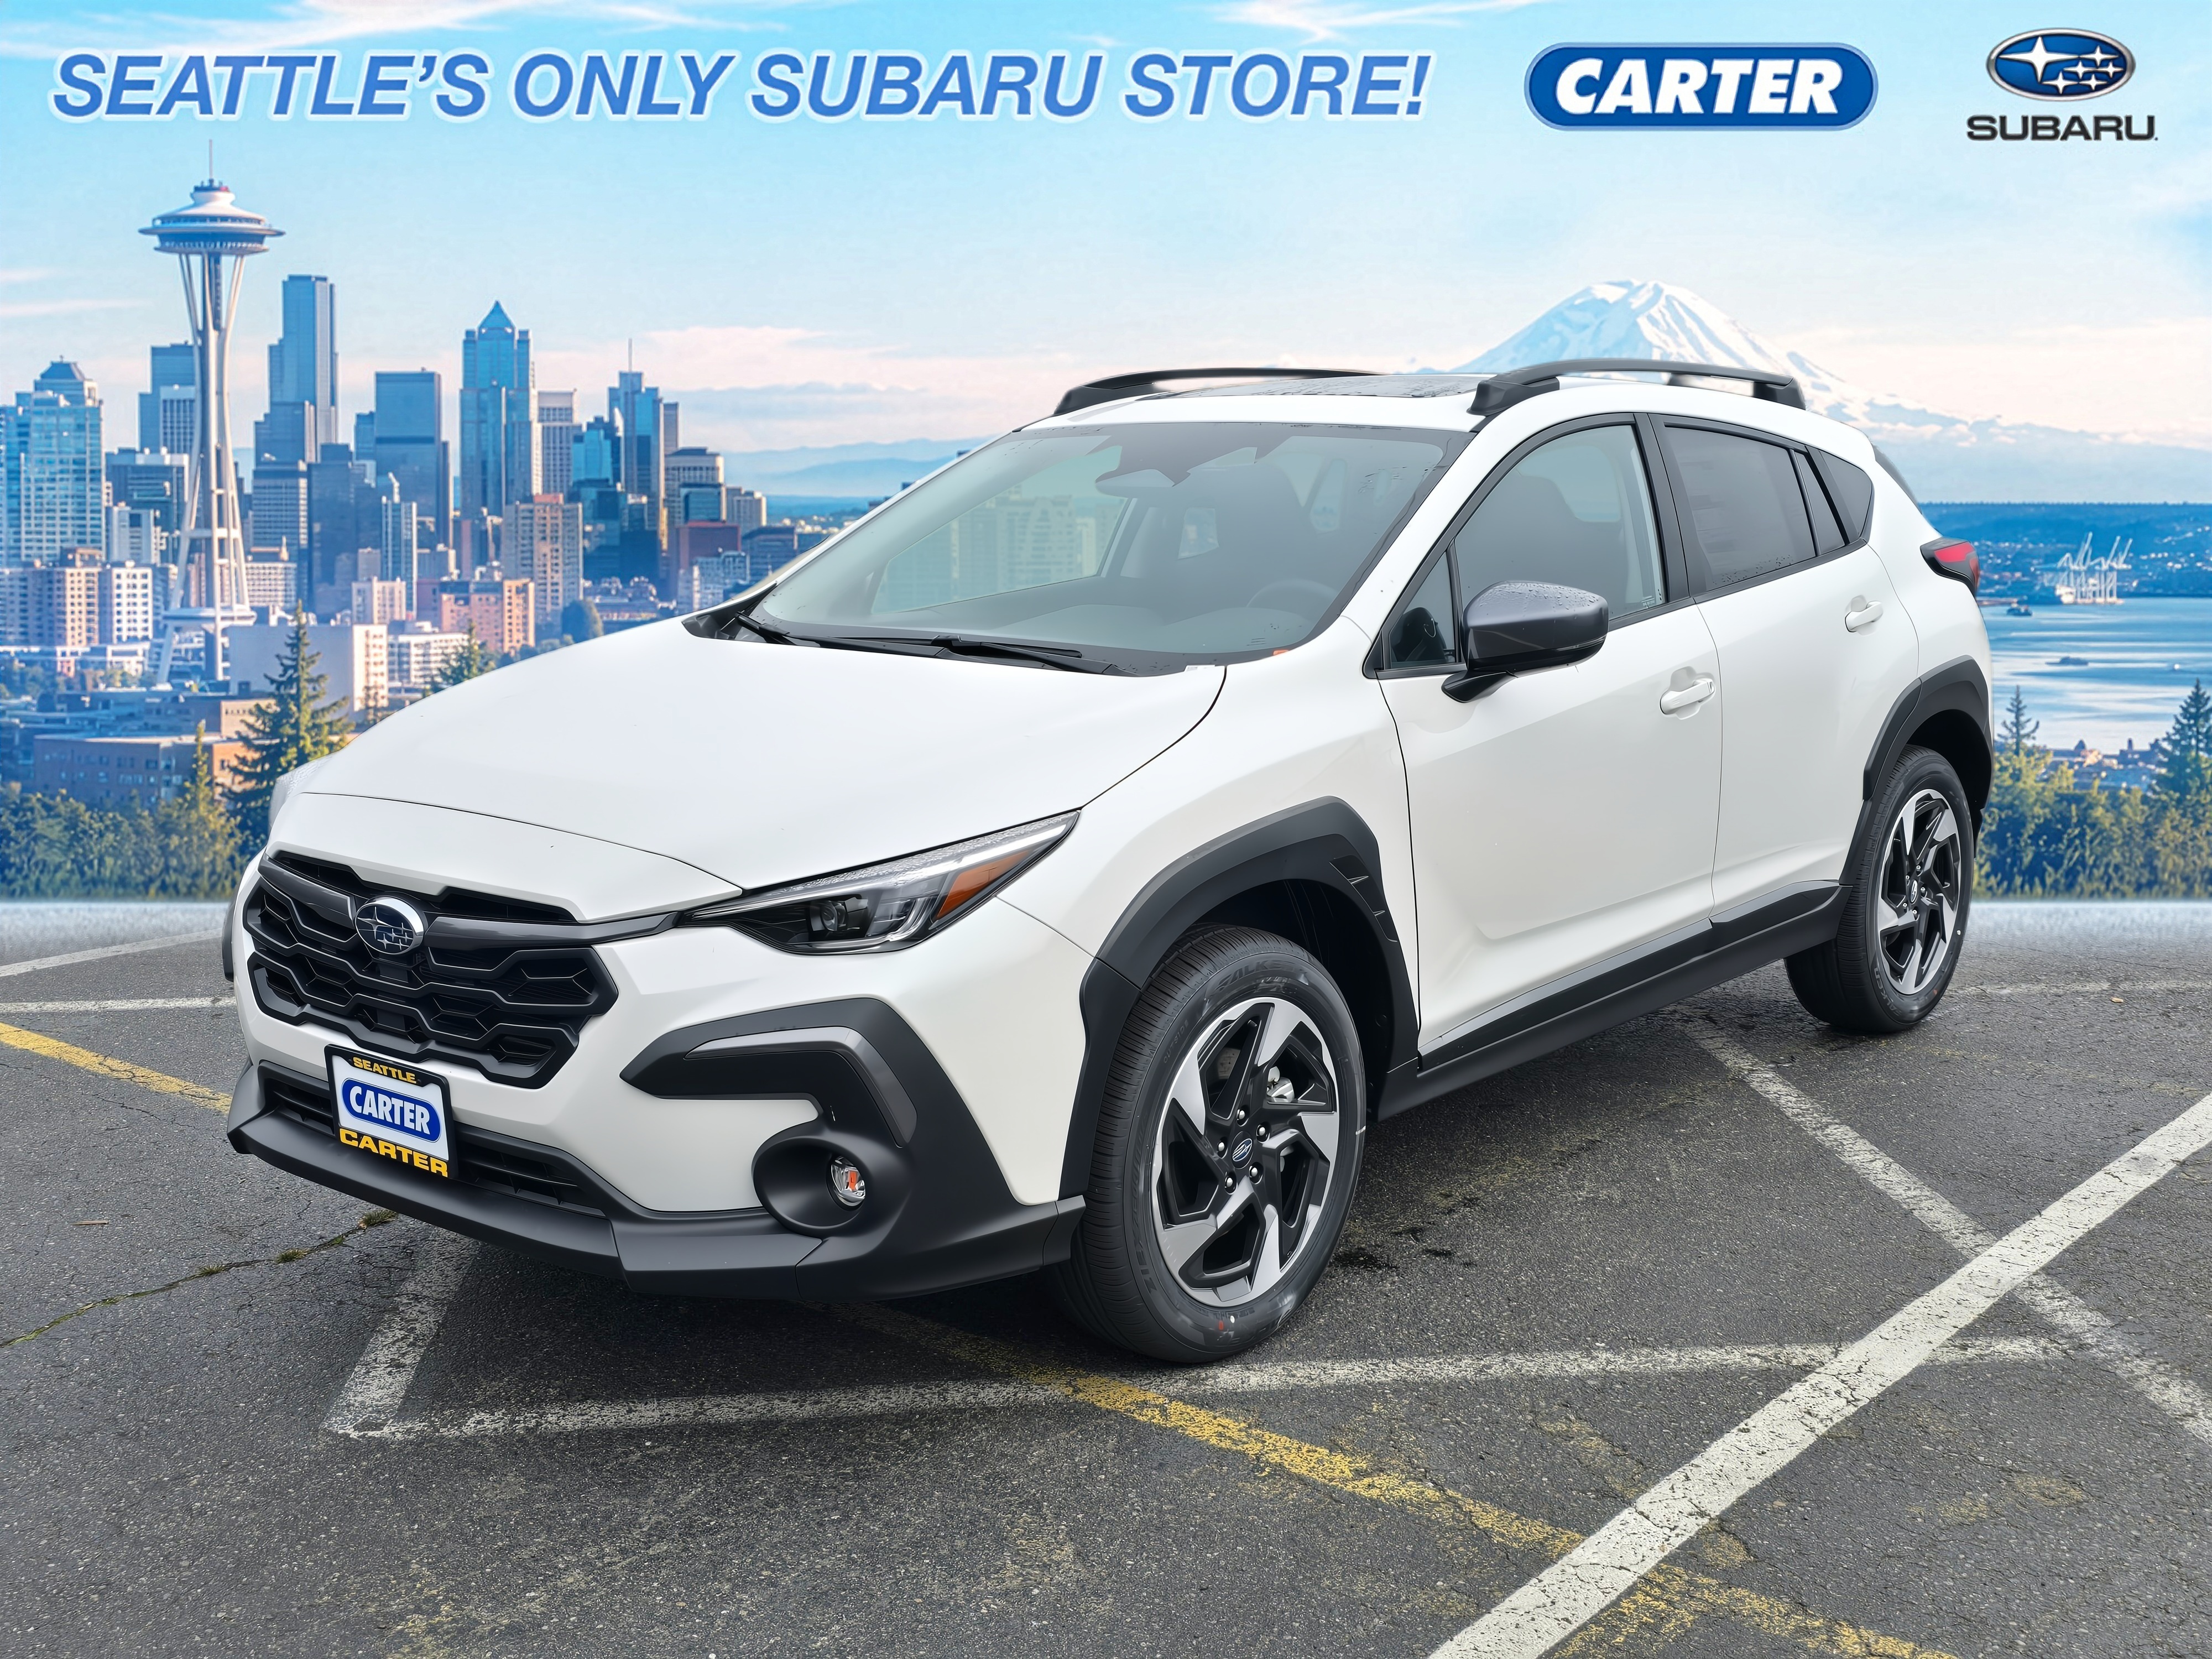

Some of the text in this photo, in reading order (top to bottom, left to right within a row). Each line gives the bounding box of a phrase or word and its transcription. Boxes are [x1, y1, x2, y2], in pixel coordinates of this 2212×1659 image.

[353, 1057, 417, 1084] SEATTLE
[349, 1086, 431, 1135] CARTER
[340, 1128, 448, 1177] CARTER
